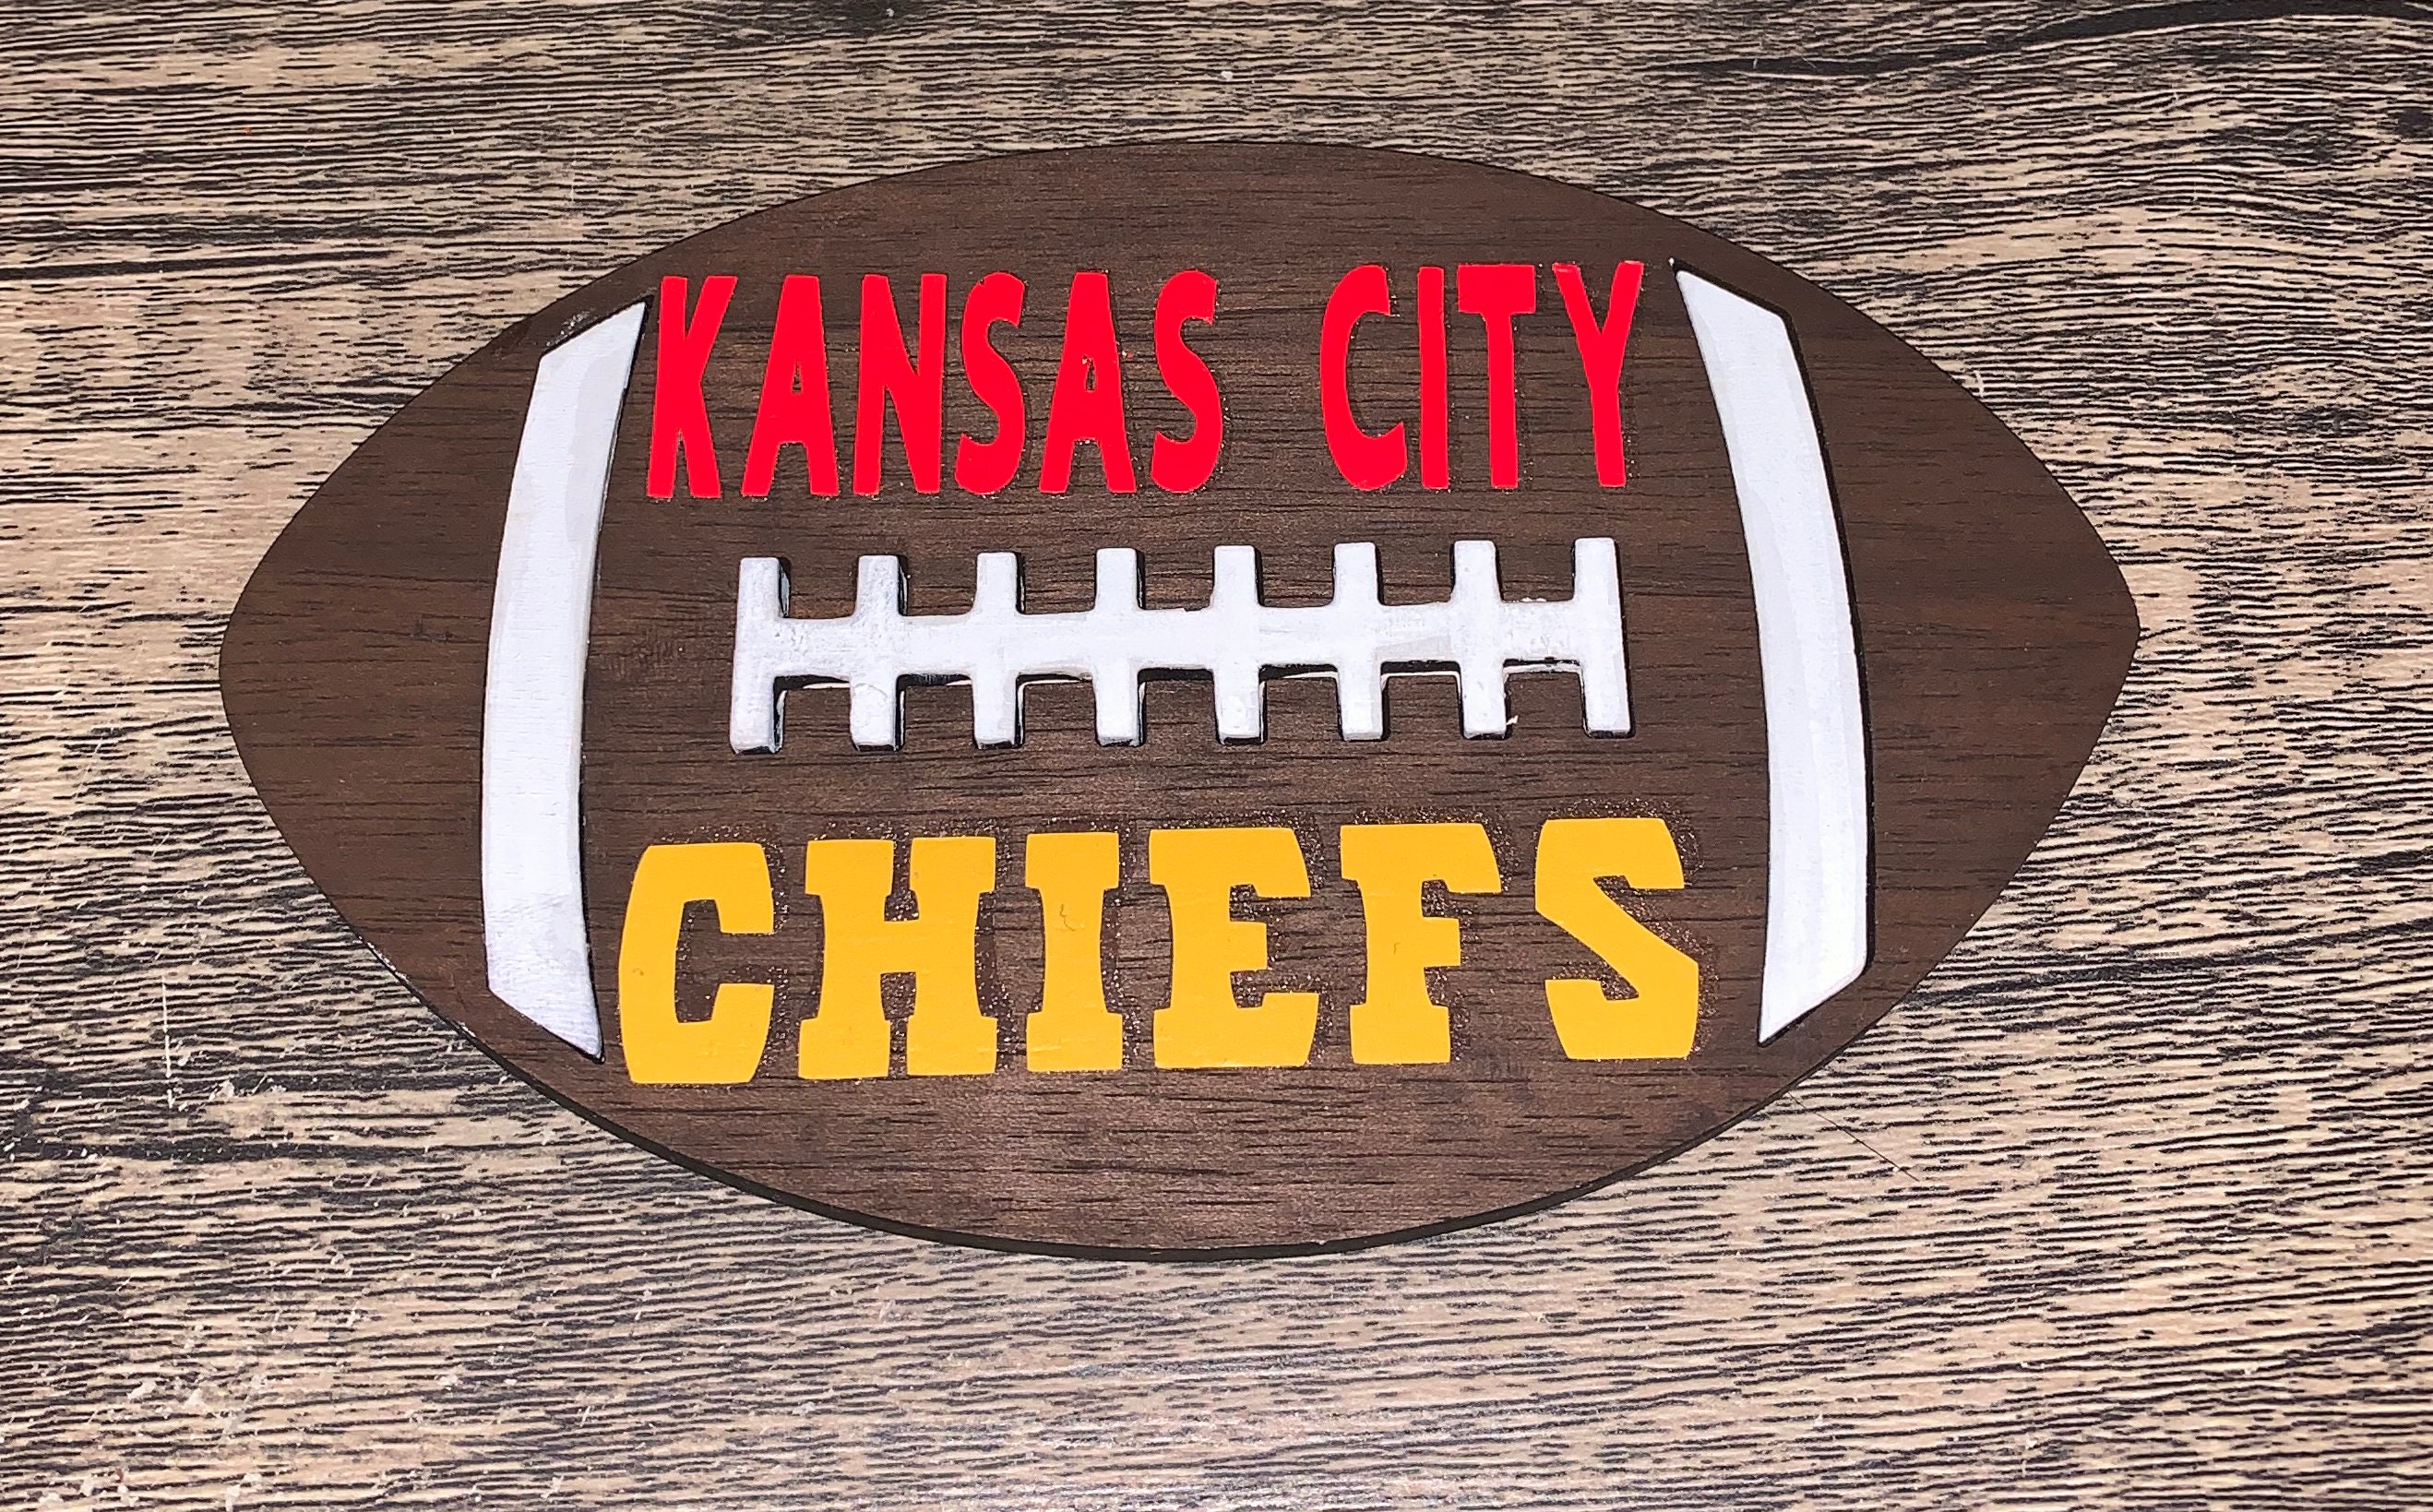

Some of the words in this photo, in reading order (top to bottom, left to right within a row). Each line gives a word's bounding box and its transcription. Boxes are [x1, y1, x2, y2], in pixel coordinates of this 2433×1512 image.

[647, 270, 1223, 498] KANSAS
[1320, 261, 1643, 490] CITY
[618, 818, 1700, 1084] CHIEFS
